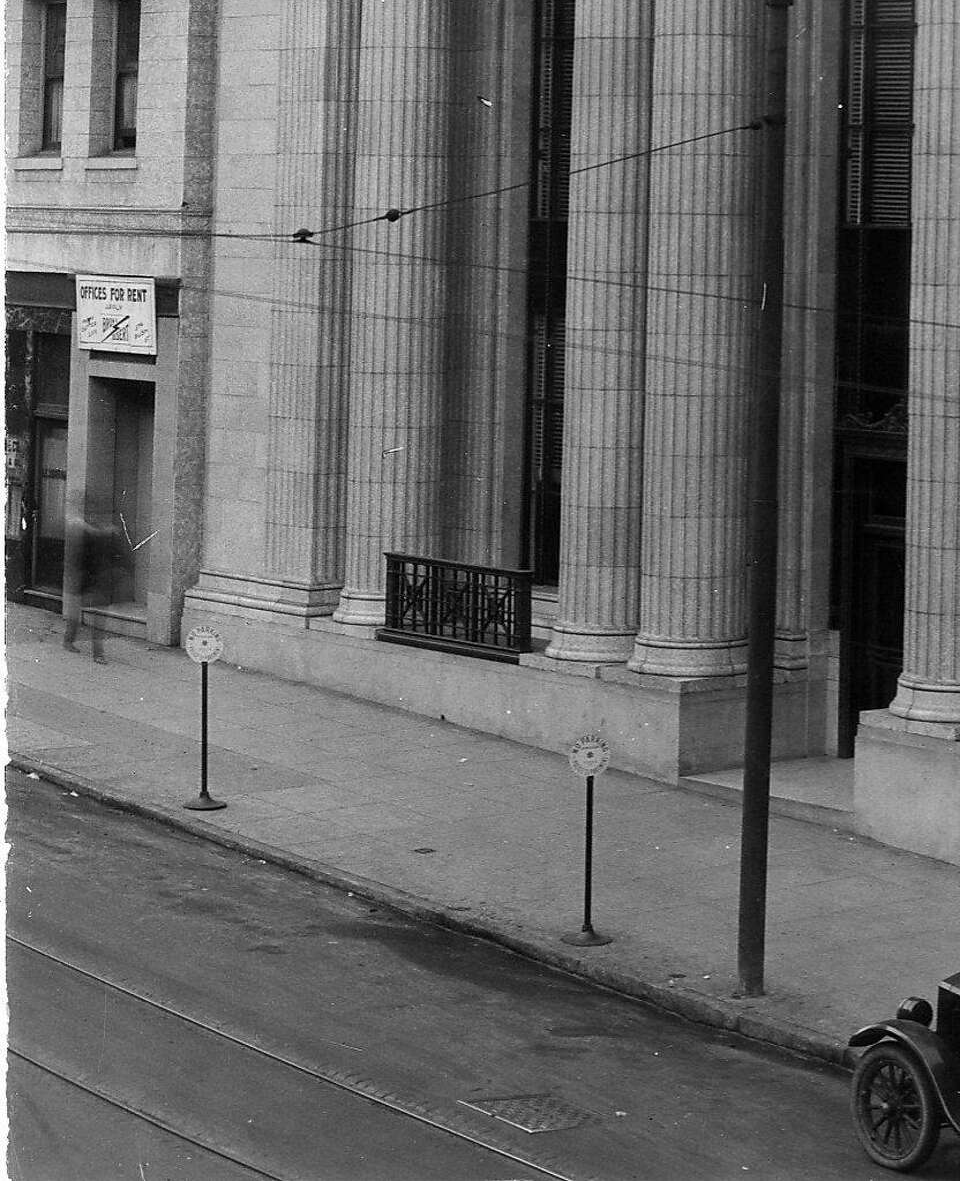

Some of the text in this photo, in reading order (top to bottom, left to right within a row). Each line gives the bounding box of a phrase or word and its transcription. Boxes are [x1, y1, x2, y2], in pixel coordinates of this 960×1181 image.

[81, 286, 147, 303] OFFICES FOR RENT
